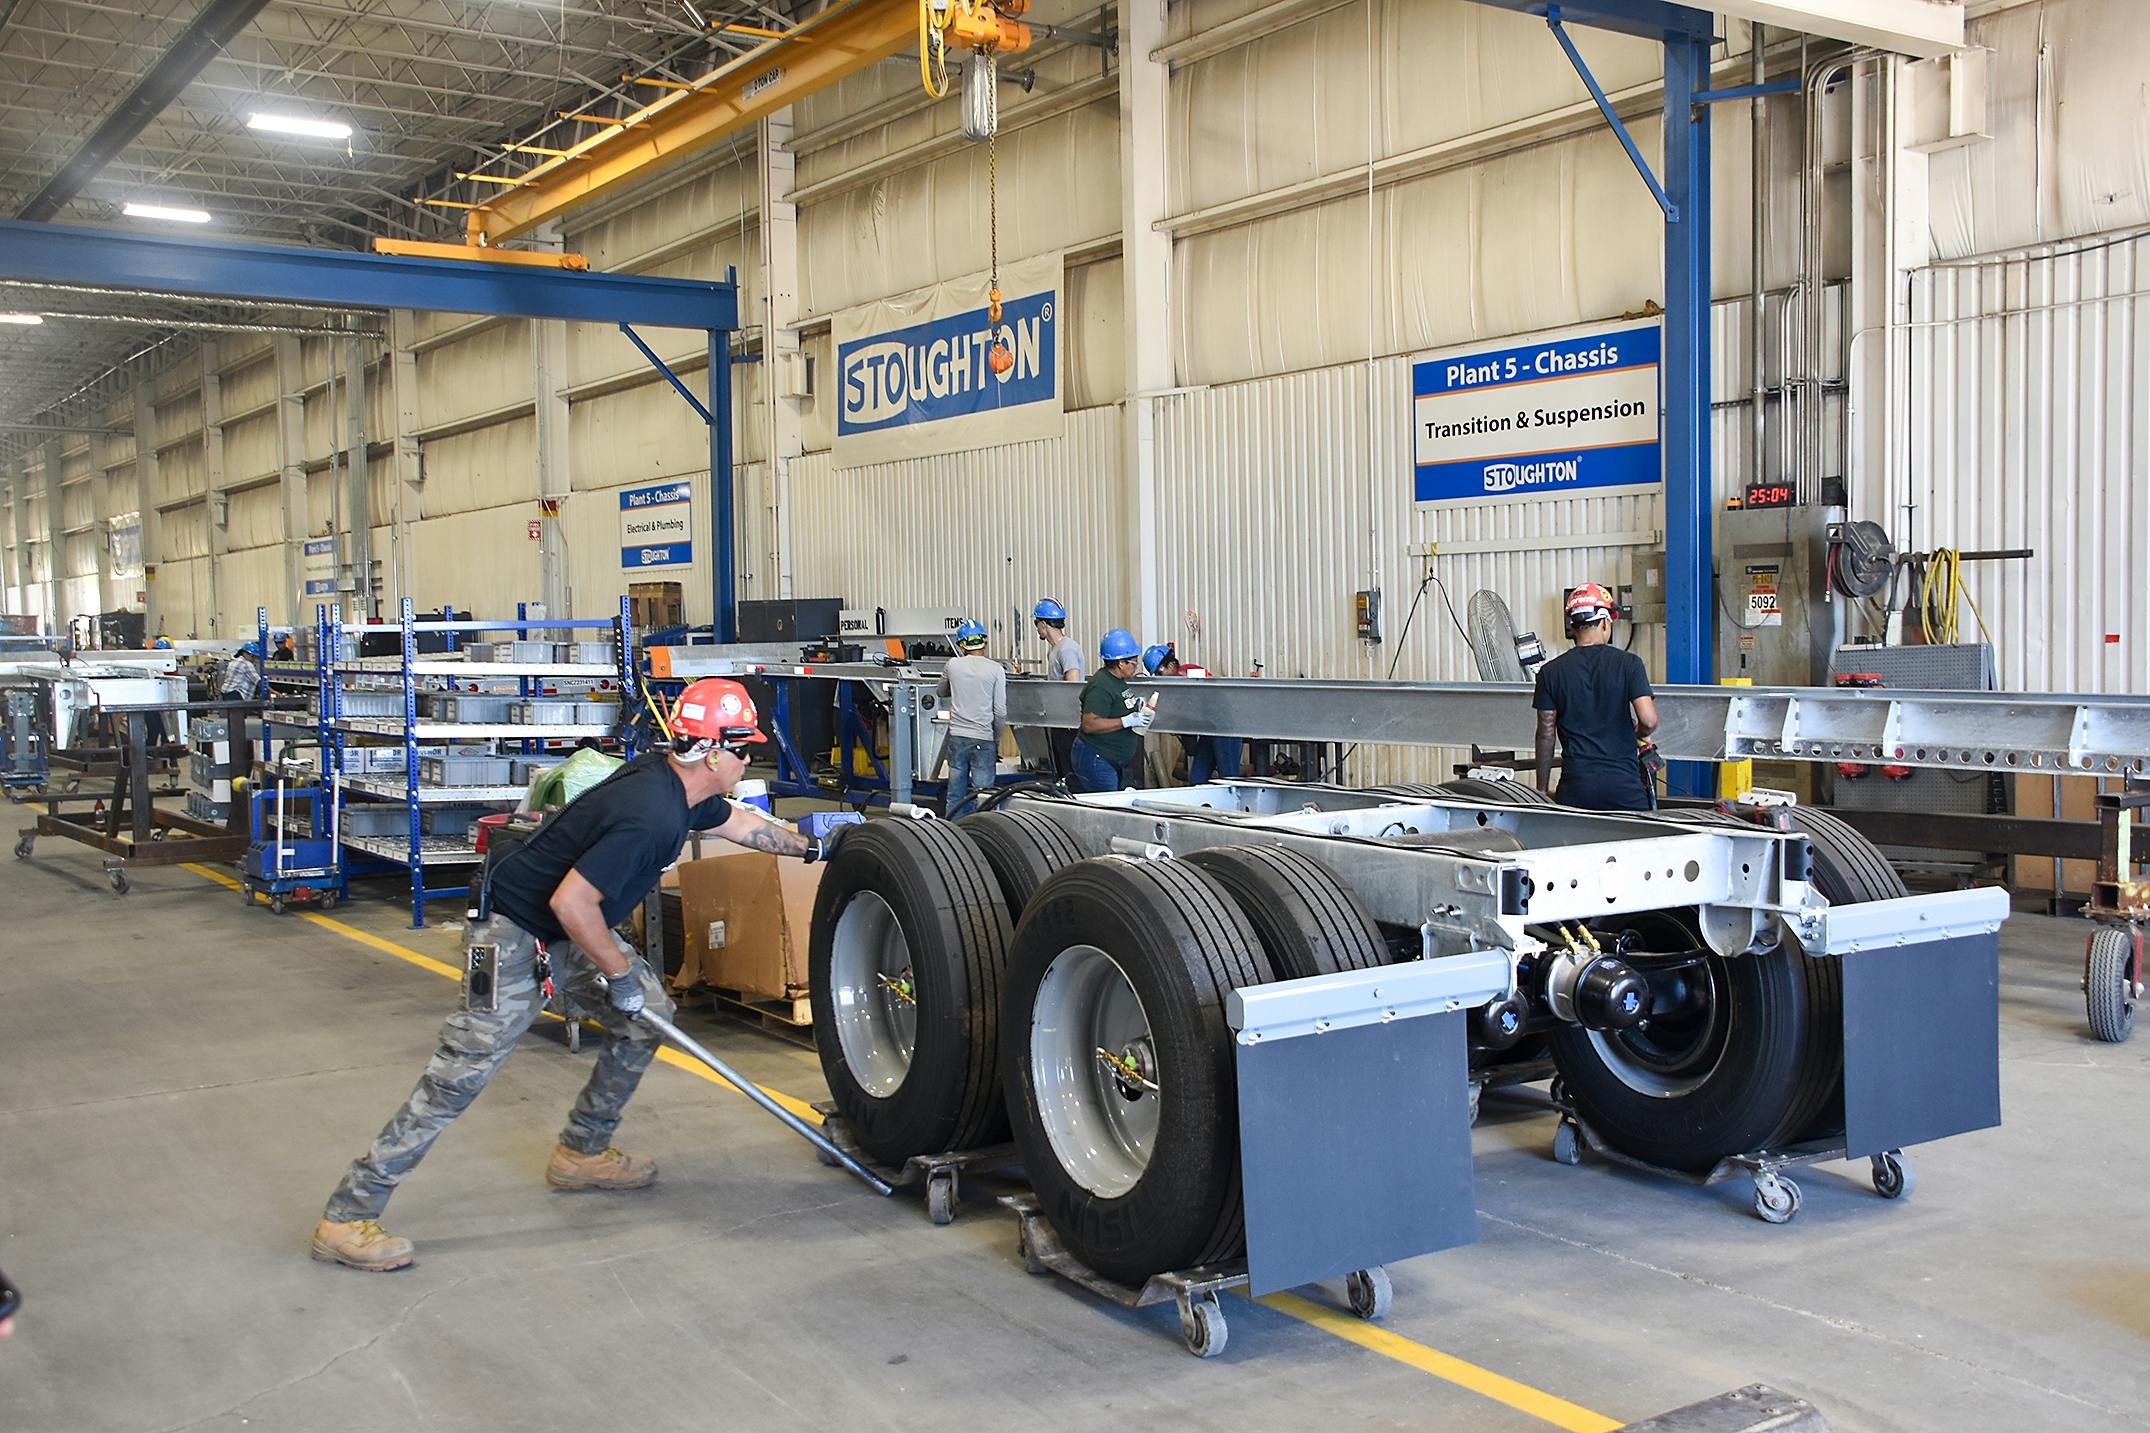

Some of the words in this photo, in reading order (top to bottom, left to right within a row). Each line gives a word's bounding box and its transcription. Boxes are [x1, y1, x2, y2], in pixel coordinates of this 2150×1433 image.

[1447, 361, 1500, 387] Plant
[1505, 357, 1516, 379] 5
[1535, 342, 1618, 374] Chassis
[1425, 415, 1511, 439] Transition
[1516, 411, 1529, 428] &
[1534, 400, 1645, 428] Suspension
[629, 493, 646, 507] Plant
[646, 492, 651, 504] 5
[655, 488, 679, 503] Chassis
[1750, 488, 1788, 504] 25:04
[627, 521, 651, 534] Electrical
[652, 521, 656, 531] &
[657, 518, 684, 531] Plumbing
[1751, 595, 1776, 609] 5092
[840, 620, 868, 631] PERSONAL
[944, 617, 963, 629] ITEMS
